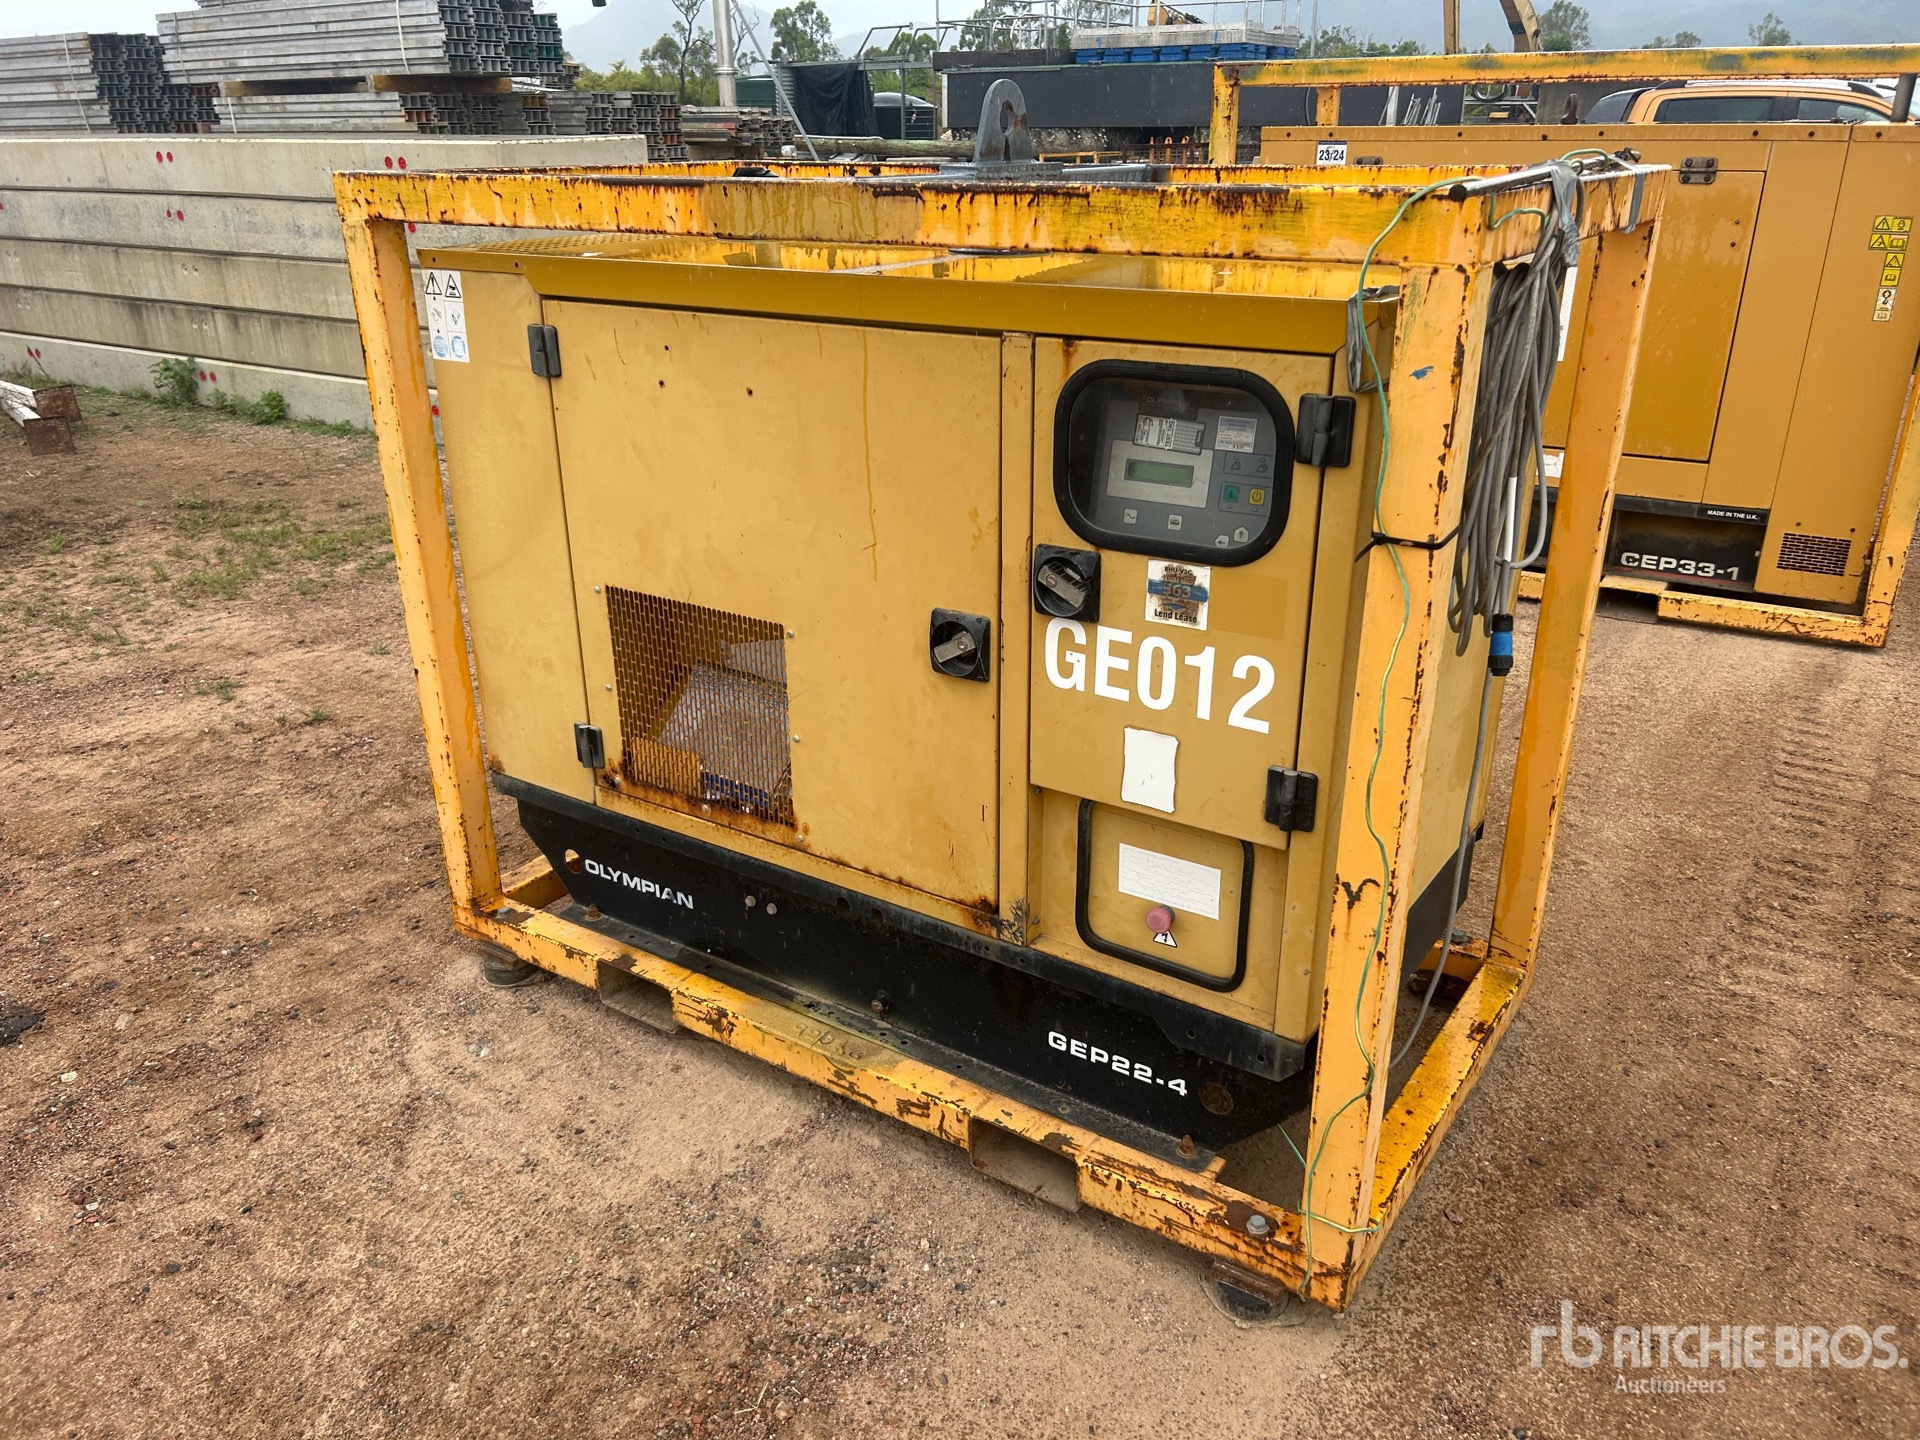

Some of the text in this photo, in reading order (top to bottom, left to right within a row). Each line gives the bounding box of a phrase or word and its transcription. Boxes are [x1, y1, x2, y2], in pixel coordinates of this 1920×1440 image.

[1318, 149, 1345, 161] 23/24
[1154, 608, 1198, 623] Lend Lease
[1045, 617, 1275, 735] GE012
[584, 858, 694, 910] OLYMPIAN
[1048, 1030, 1188, 1097] GEP22-4
